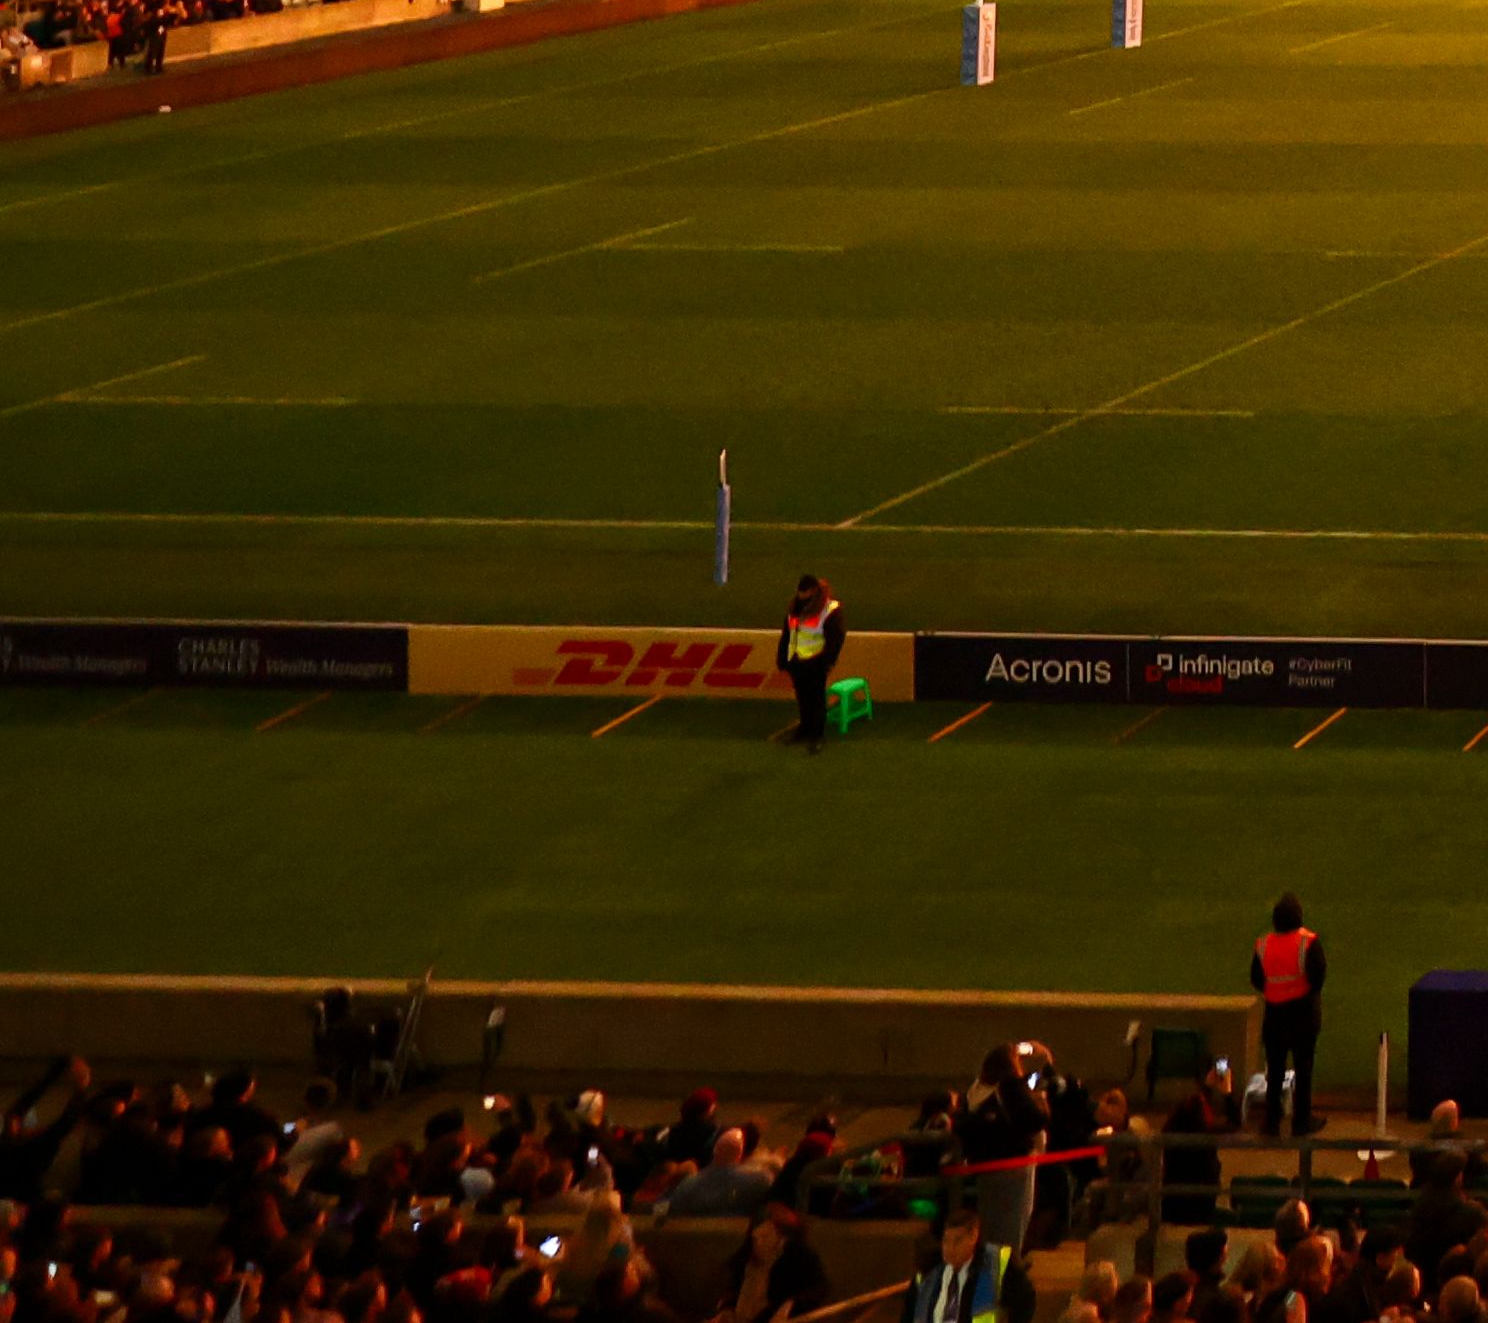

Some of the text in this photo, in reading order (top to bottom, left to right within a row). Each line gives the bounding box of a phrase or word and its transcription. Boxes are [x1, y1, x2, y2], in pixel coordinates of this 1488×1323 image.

[554, 641, 768, 686] DHL
[985, 653, 1111, 685] Acronis
[1179, 654, 1274, 679] infinigate
